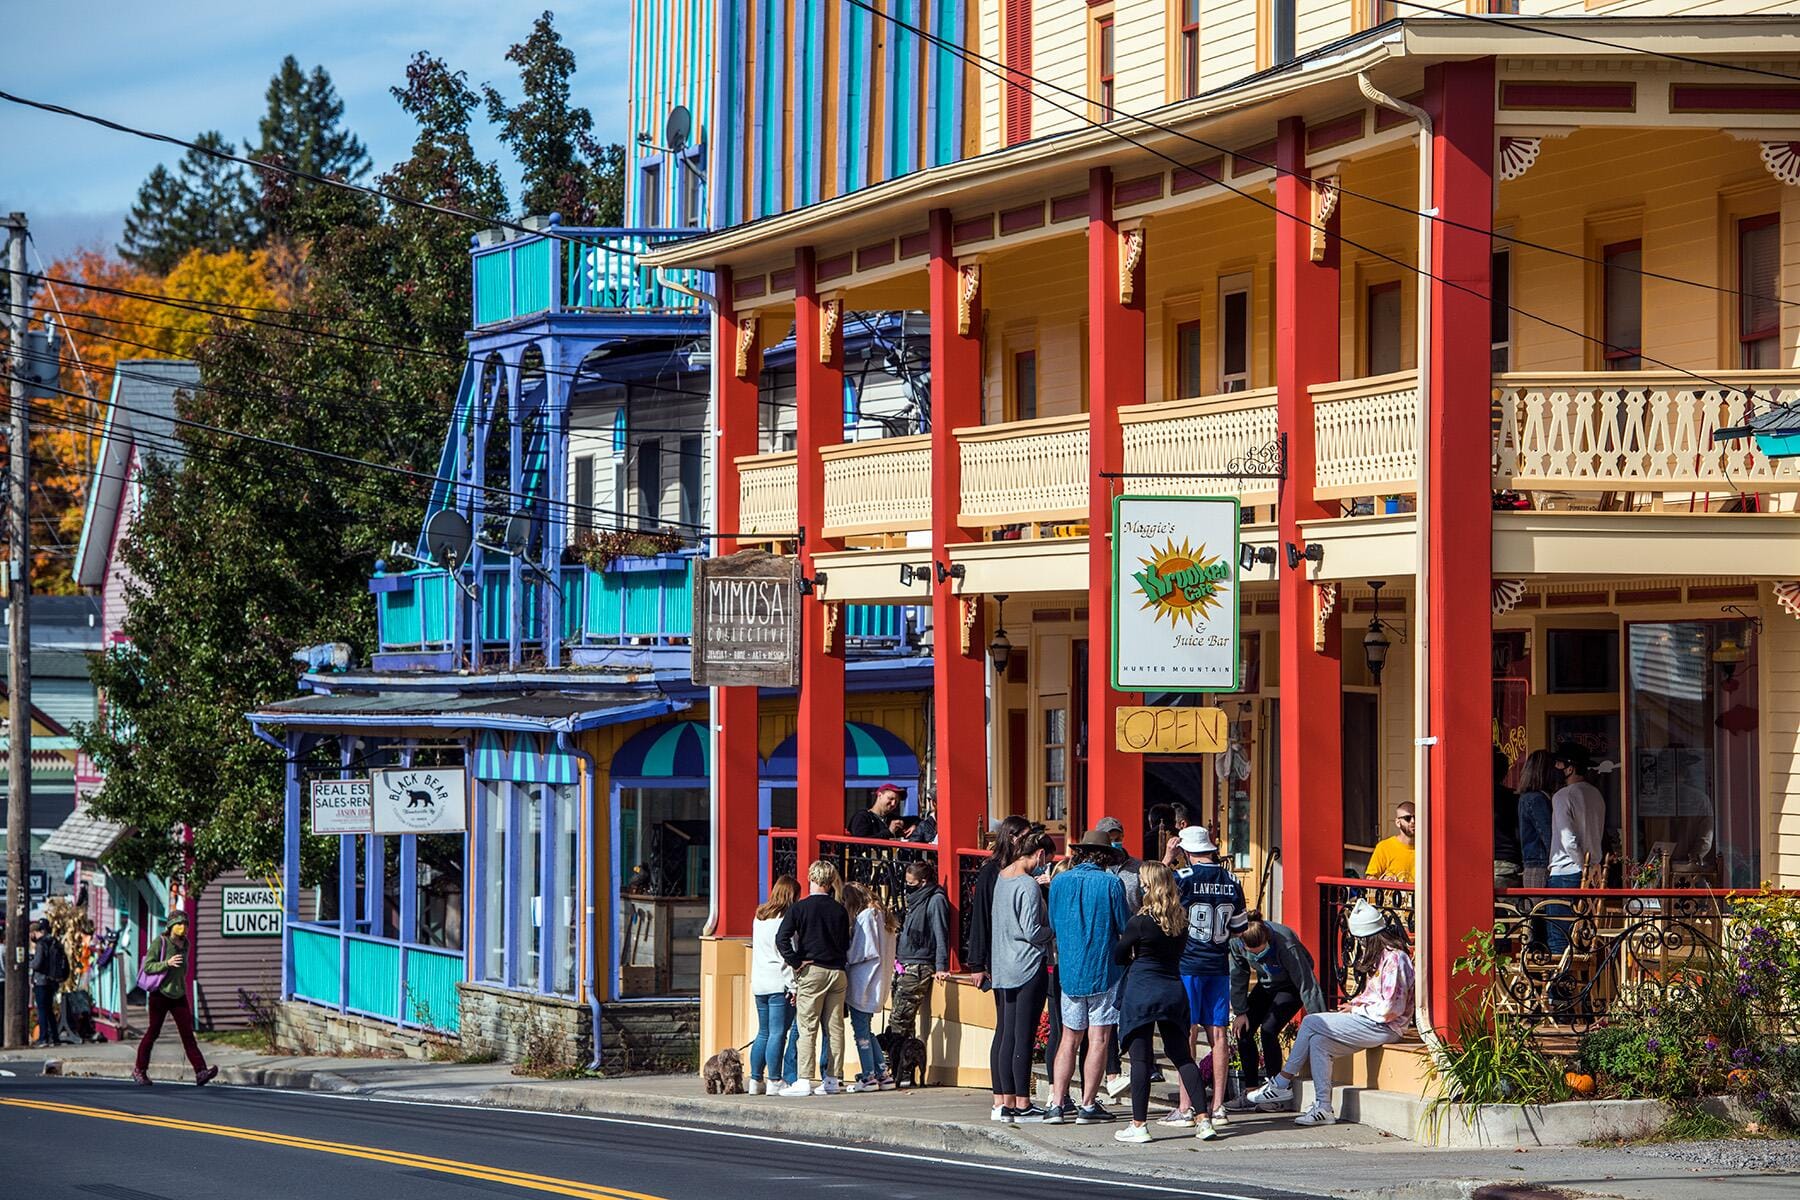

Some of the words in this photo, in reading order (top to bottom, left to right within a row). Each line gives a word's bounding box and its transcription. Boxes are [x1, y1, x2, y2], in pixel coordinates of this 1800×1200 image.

[1123, 520, 1176, 539] Maggie's
[1132, 560, 1230, 604] Krooked
[1183, 583, 1217, 602] Cafe
[709, 580, 785, 625] MIMOSA
[707, 627, 784, 643] COLLECTIVE
[1195, 622, 1207, 634] &
[1173, 634, 1205, 648] Juice
[1207, 635, 1230, 647] Bar
[1124, 708, 1218, 750] OPEN
[315, 784, 347, 796] REAL
[389, 772, 418, 801] BLACK
[424, 774, 449, 800] BEAR
[226, 914, 279, 931] LUNCH
[1188, 902, 1235, 944] 90
